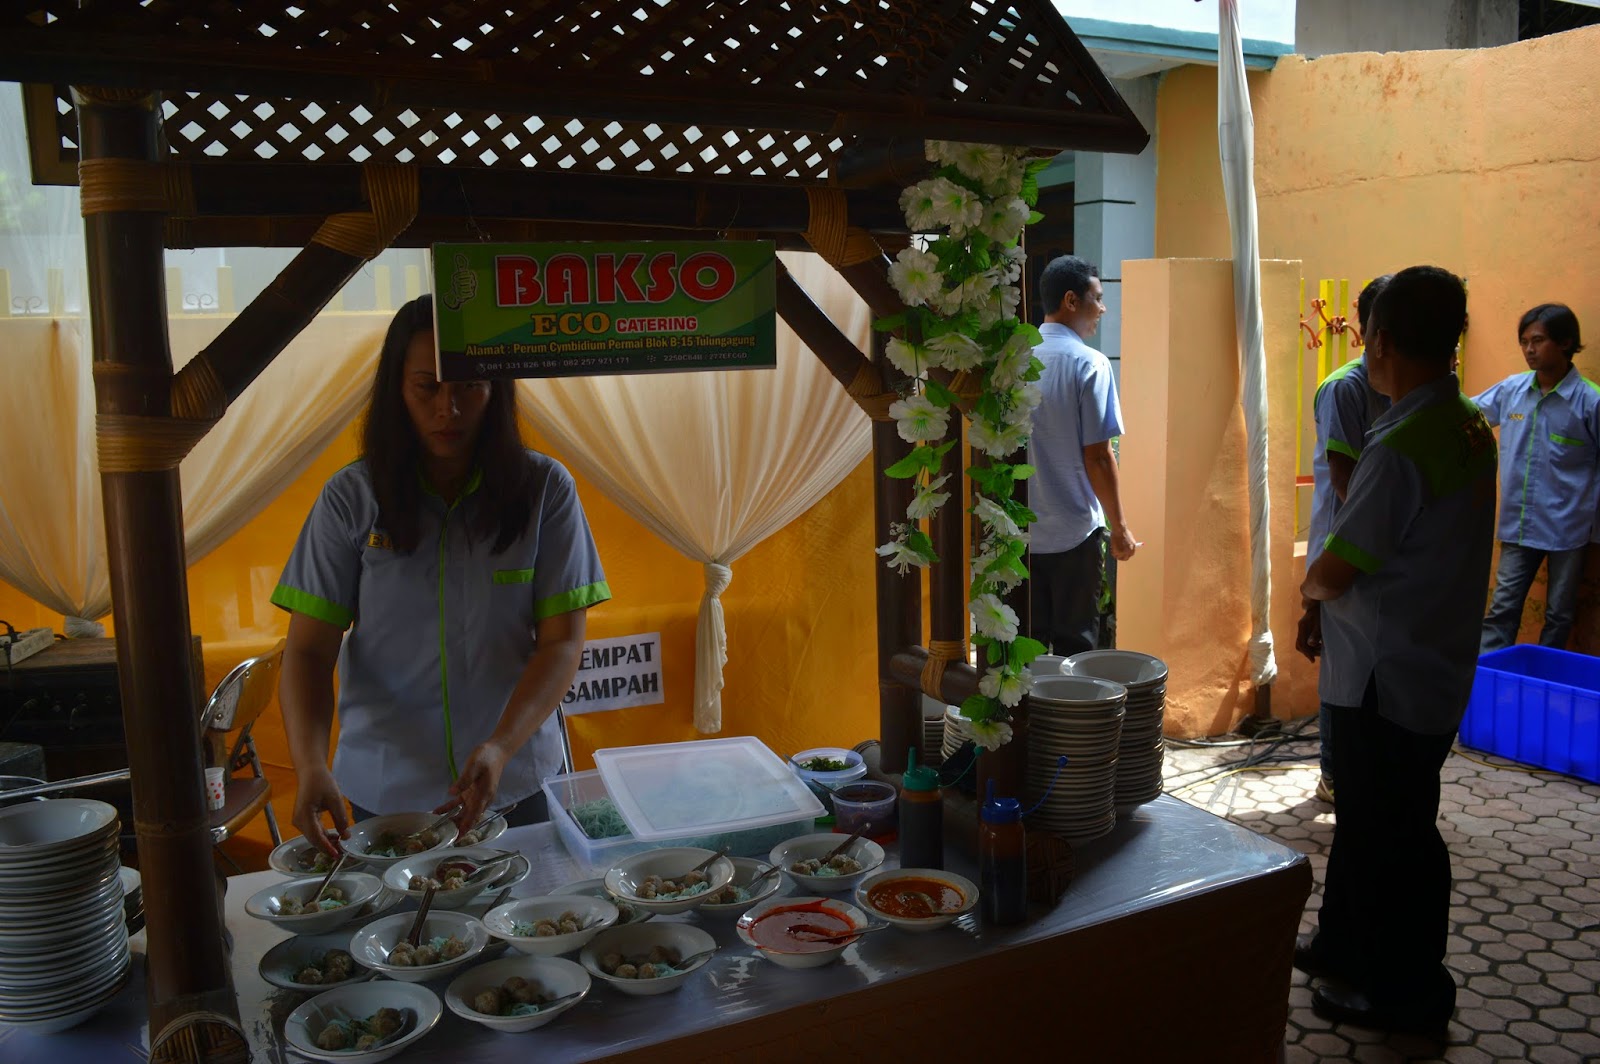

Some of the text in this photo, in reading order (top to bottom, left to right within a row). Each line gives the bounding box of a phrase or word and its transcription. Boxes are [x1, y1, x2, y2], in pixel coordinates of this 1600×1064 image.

[495, 251, 737, 307] BAKSO
[530, 311, 698, 337] ECO CATERING
[466, 344, 505, 356] Alamat
[513, 343, 547, 354] Perum
[549, 340, 606, 355] Cymbidium
[608, 337, 643, 349] Permai
[646, 336, 669, 348] Blok
[670, 335, 694, 347] B-15
[695, 335, 756, 347] Tulungagung
[563, 359, 579, 367] 082
[581, 358, 596, 366] 257
[577, 642, 655, 671] EMPAT
